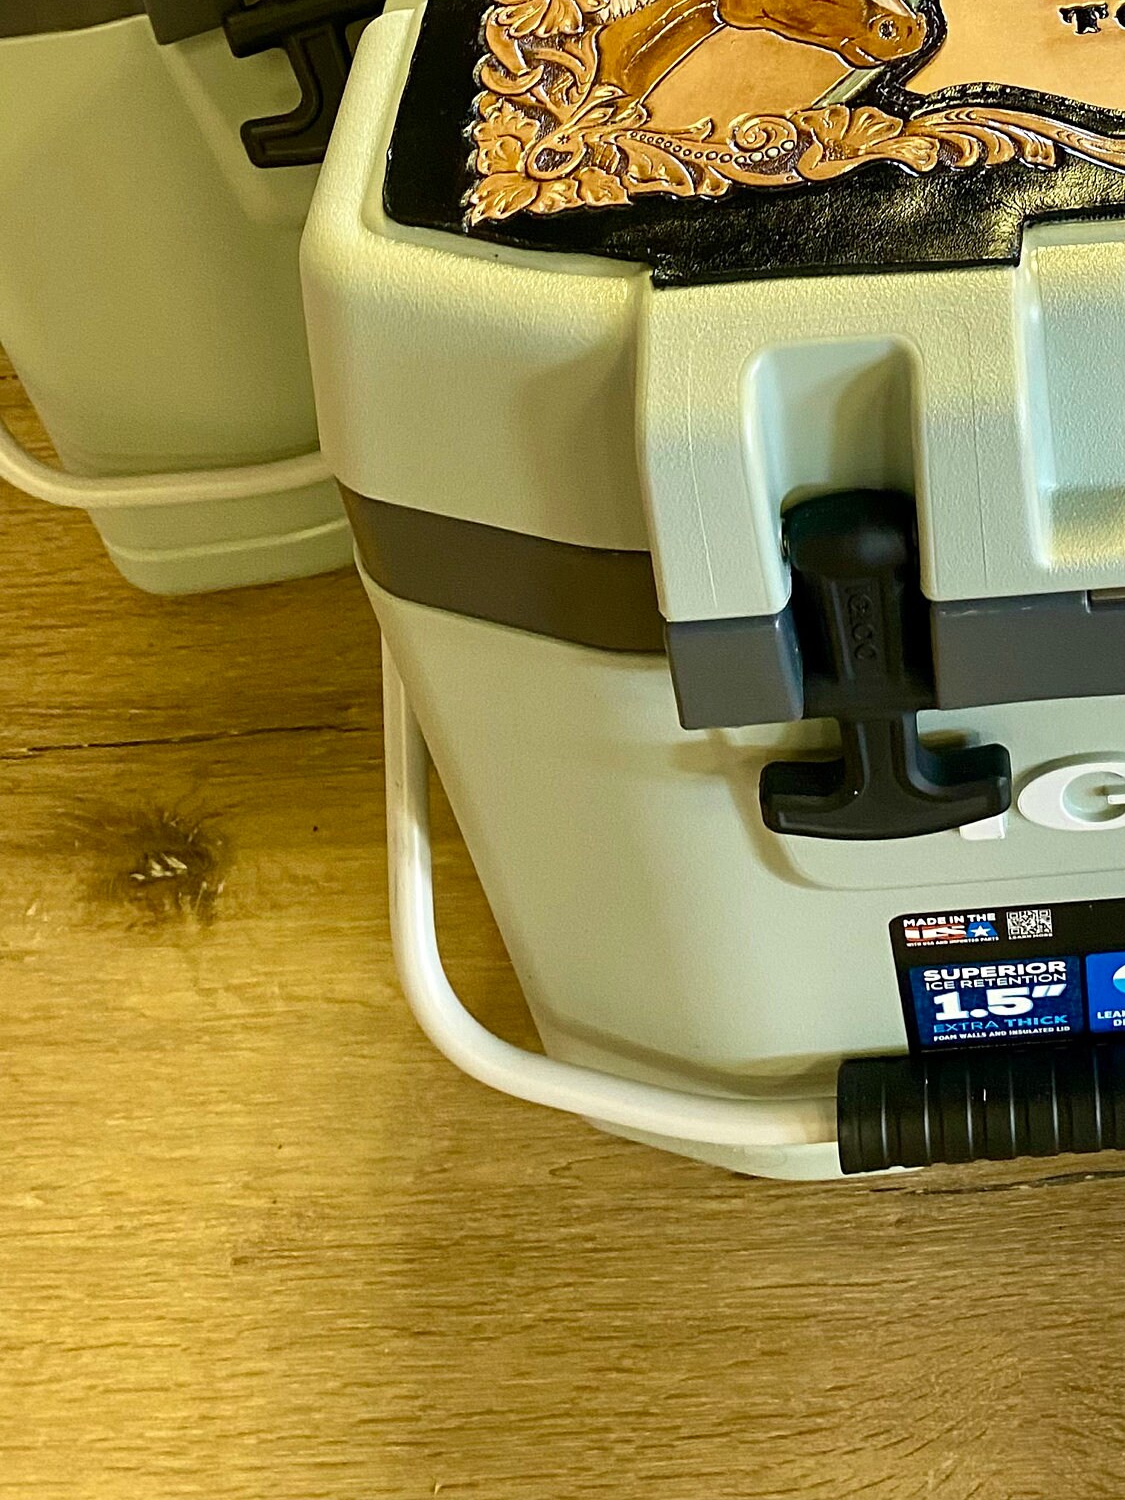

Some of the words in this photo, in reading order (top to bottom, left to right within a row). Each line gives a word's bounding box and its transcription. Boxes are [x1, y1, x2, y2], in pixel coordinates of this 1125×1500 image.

[848, 586, 877, 660] GLOO
[903, 916, 947, 928] MADE
[950, 914, 964, 923] IN
[967, 912, 996, 923] THE
[923, 961, 1067, 982] SUPERIOR
[926, 980, 955, 991] ICE
[960, 972, 1067, 989] RETENTION
[933, 1020, 999, 1034] EXTRA
[1004, 1014, 1068, 1028] THICK
[933, 1034, 957, 1042] FOAM
[959, 1031, 987, 1039] WALLS
[989, 1029, 1007, 1037] AND
[1009, 1026, 1055, 1036] INSULATED
